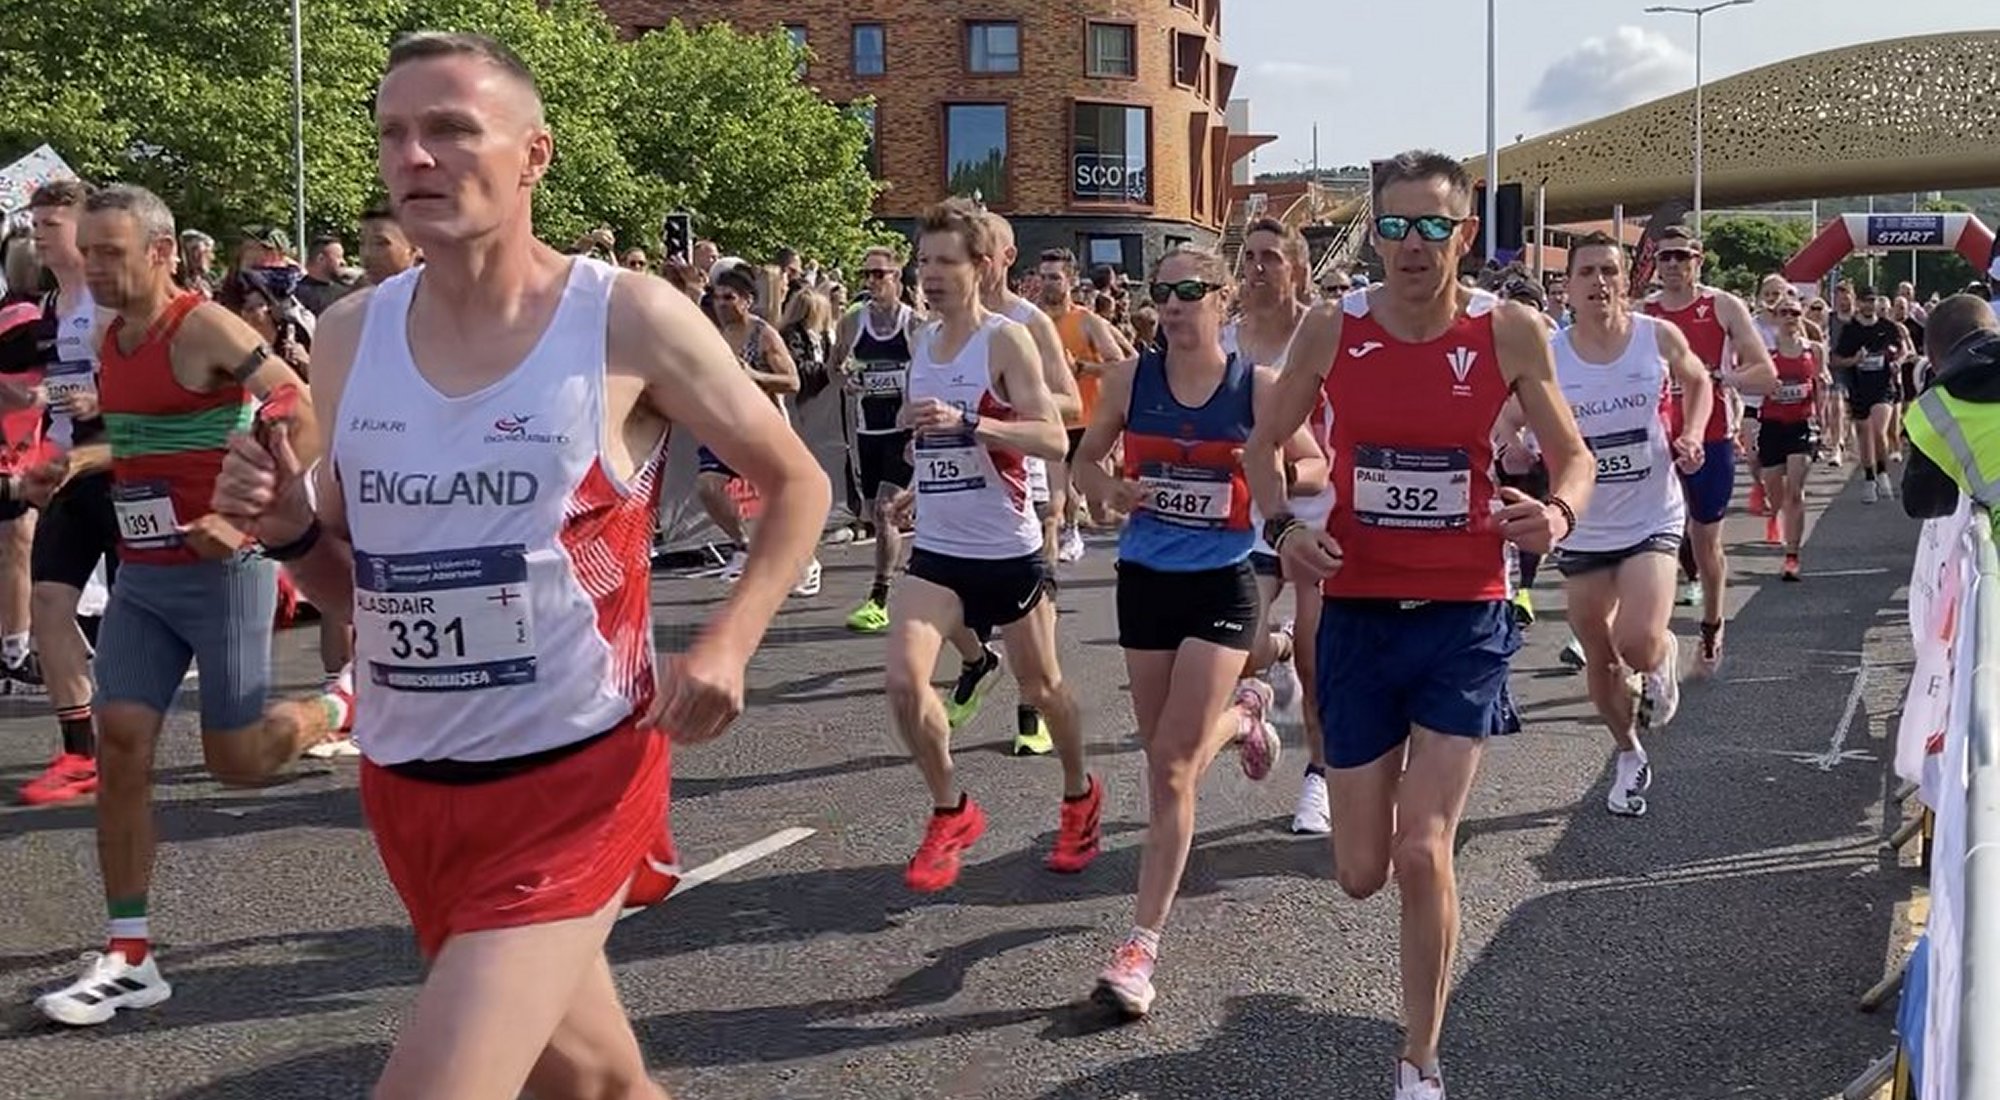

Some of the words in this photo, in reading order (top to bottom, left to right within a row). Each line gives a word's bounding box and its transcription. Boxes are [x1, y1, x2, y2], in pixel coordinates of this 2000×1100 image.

[1877, 230, 1934, 244] START
[1571, 393, 1648, 418] ENGLAND
[929, 461, 959, 480] 125
[1598, 455, 1632, 473] 353
[359, 470, 539, 505] ENGLAND
[1356, 470, 1388, 483] PAUL
[1156, 491, 1212, 515] 6487
[1386, 486, 1438, 511] 352
[124, 514, 159, 535] 1391
[388, 617, 466, 659] 331
